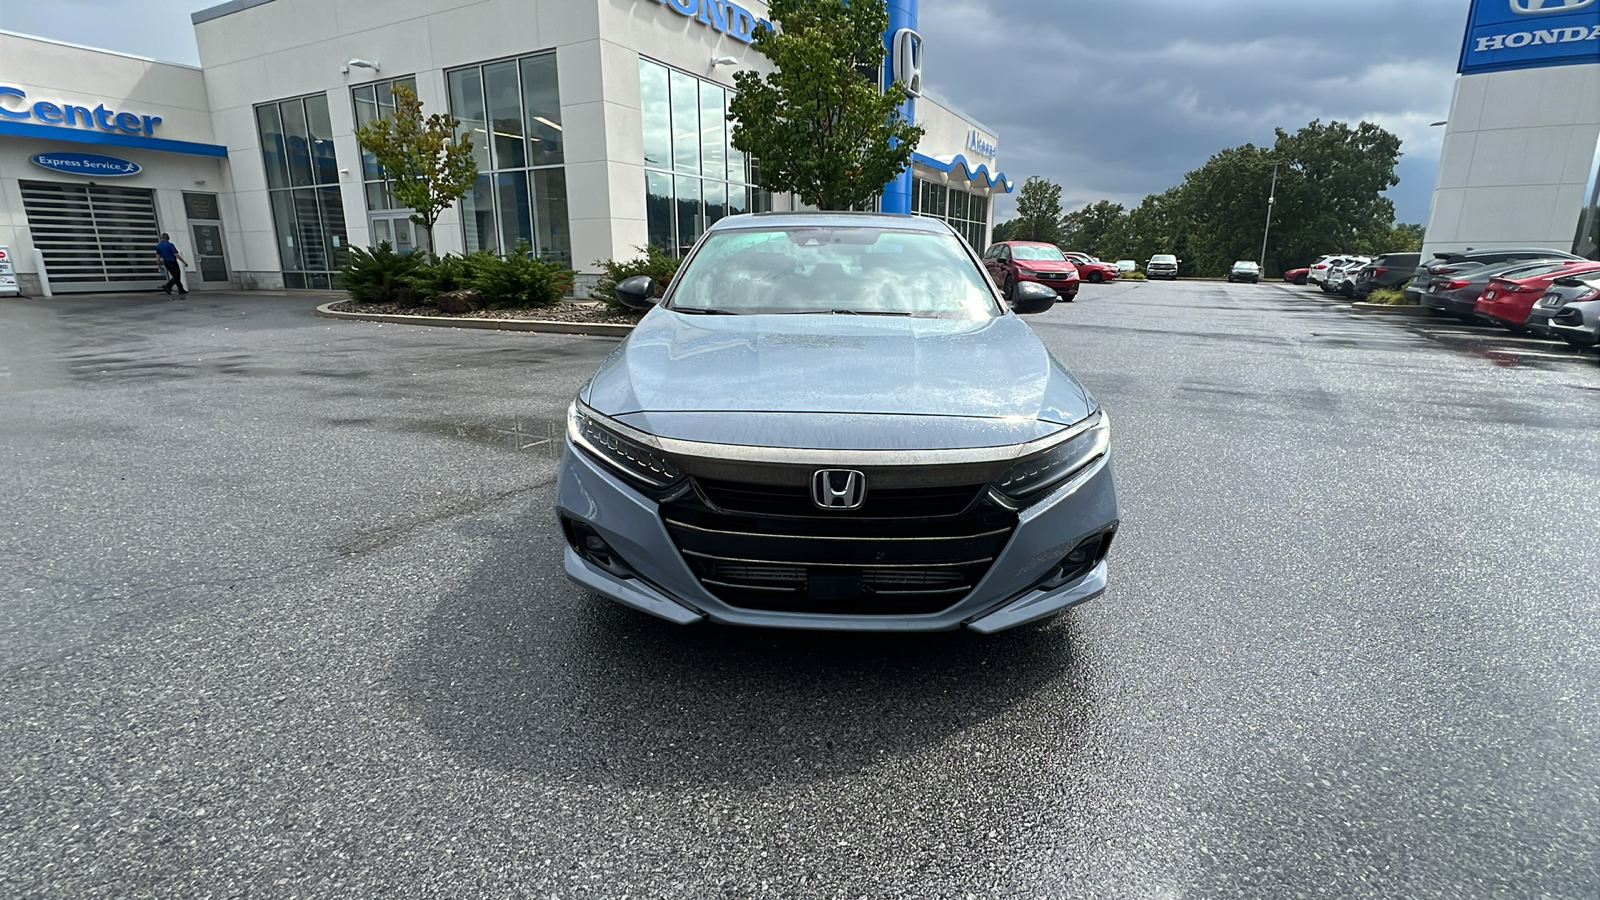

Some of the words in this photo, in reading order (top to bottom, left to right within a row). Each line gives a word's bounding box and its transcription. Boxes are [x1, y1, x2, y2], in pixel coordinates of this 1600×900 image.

[642, 0, 773, 43] OND
[0, 86, 162, 135] Center
[38, 156, 82, 168] Express
[83, 160, 122, 170] Service
